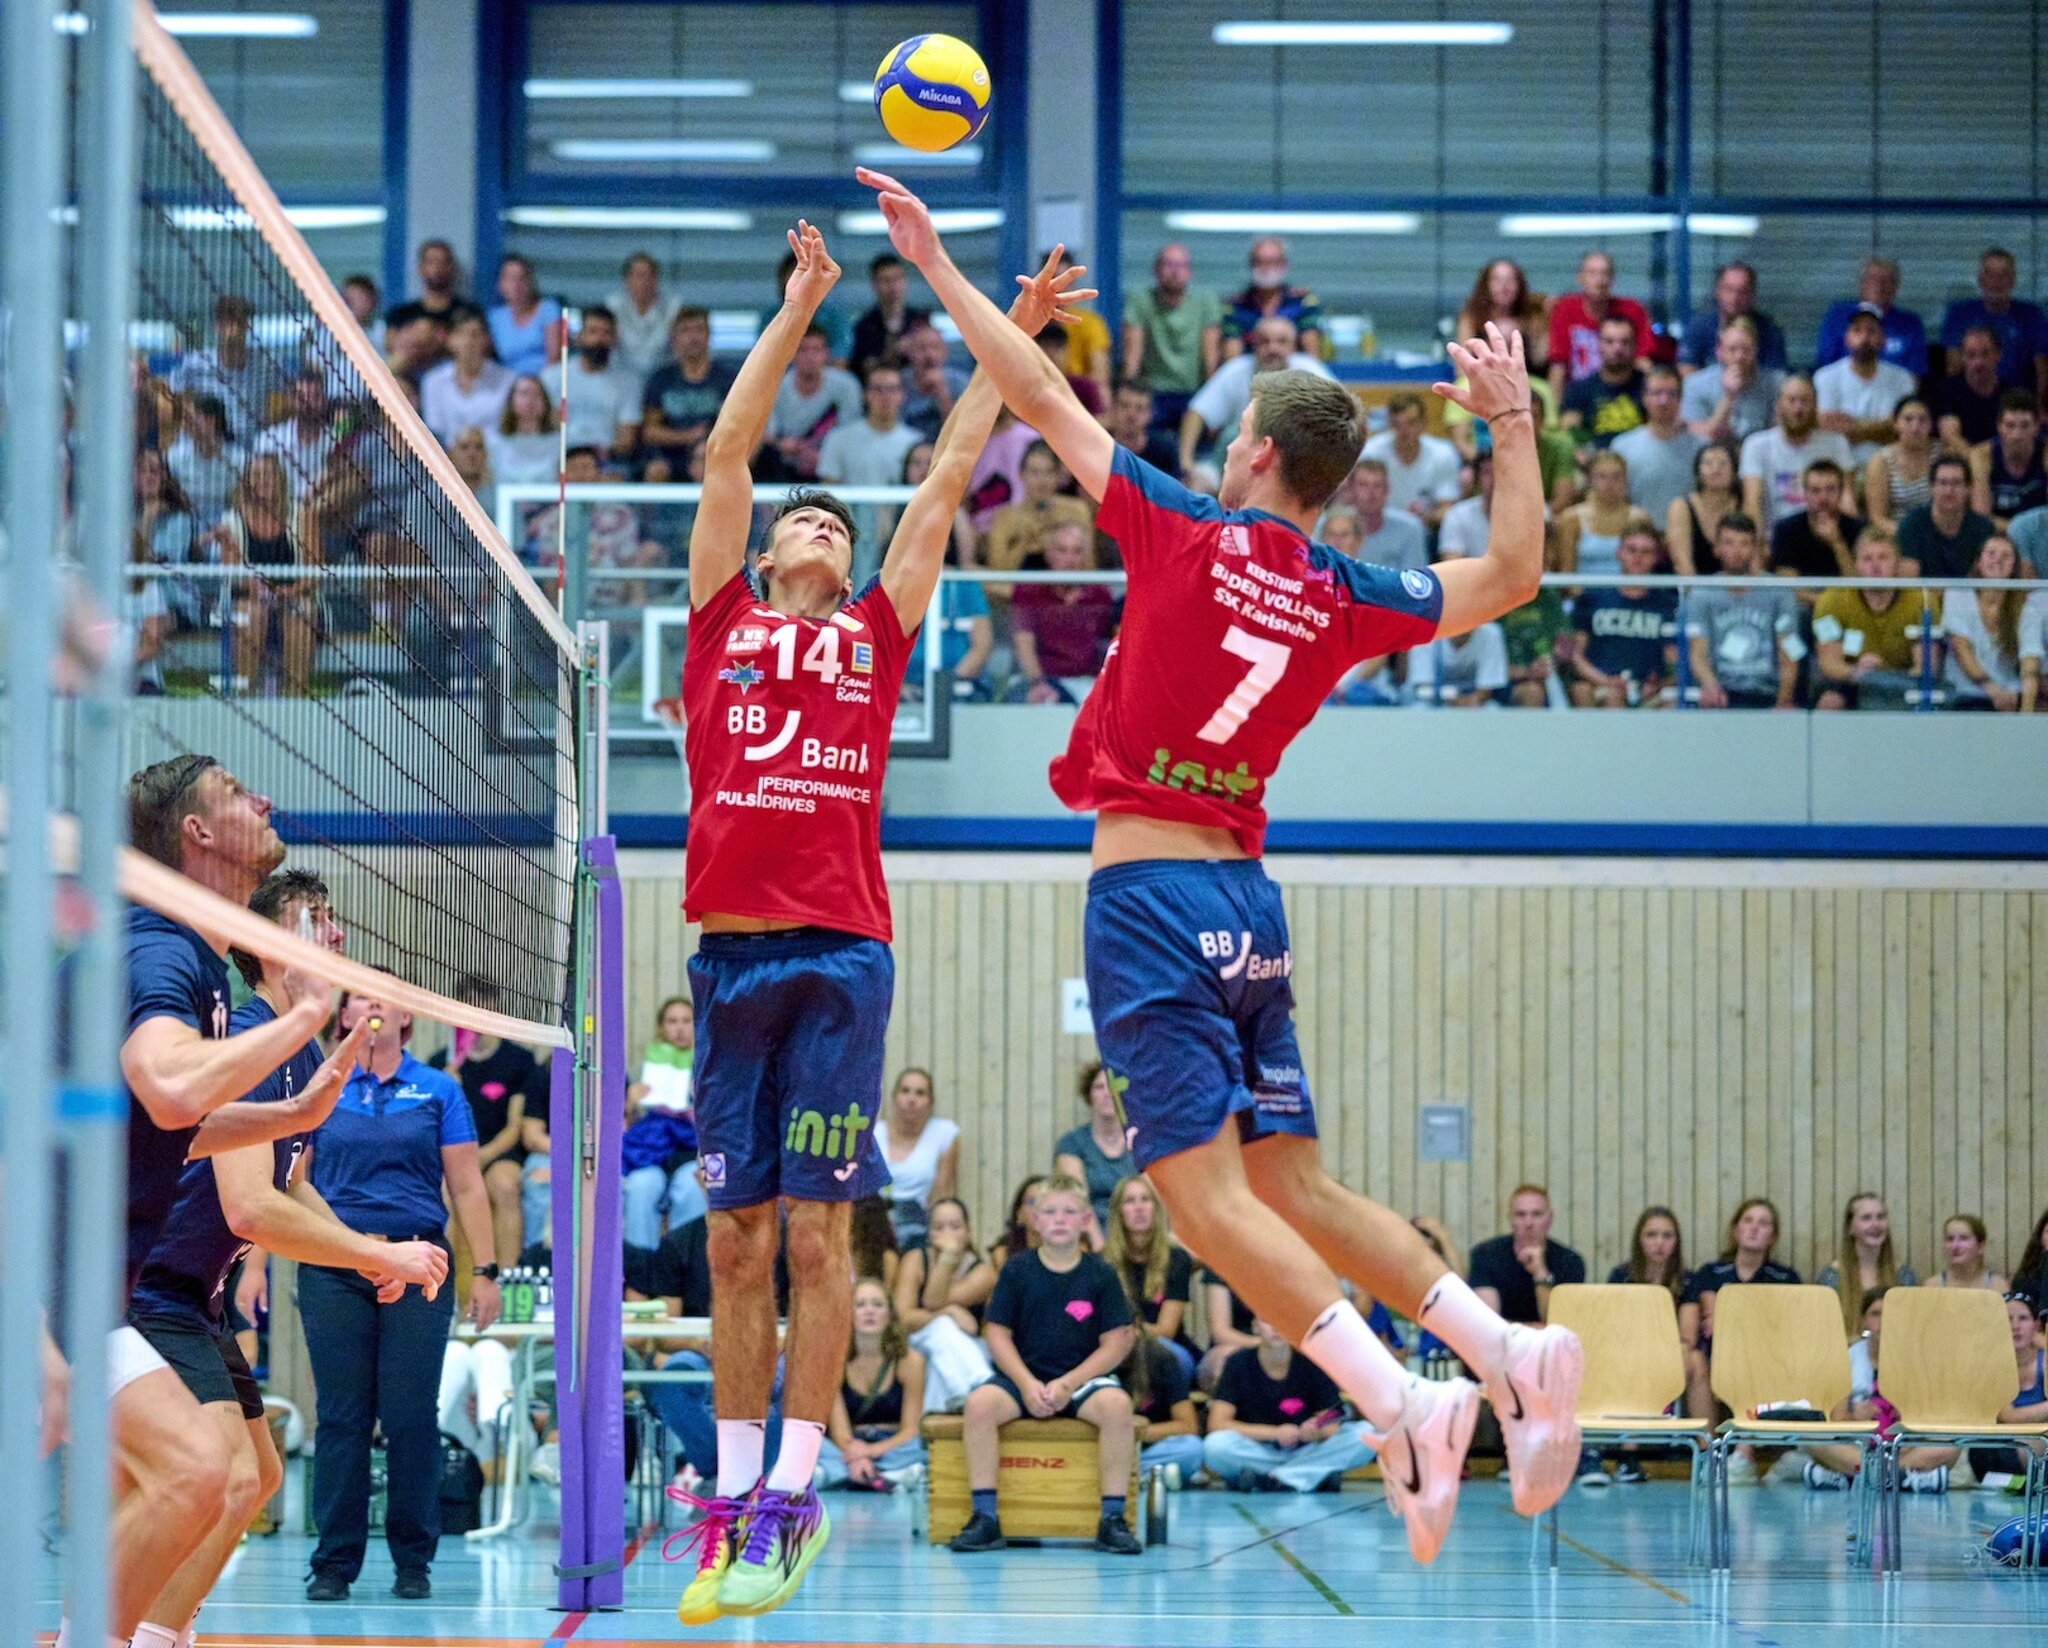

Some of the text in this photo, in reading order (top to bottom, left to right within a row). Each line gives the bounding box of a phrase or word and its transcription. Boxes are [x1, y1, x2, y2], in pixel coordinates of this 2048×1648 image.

[1245, 561, 1304, 595] KERSTING
[1240, 601, 1317, 643] Karlsruhe
[1263, 590, 1331, 628] VOLLEYS
[769, 624, 842, 684] 14
[1196, 624, 1292, 745] 7
[727, 704, 767, 735] BB
[716, 790, 816, 814] PULS DRIVES
[763, 776, 871, 804] PERFORMANCE
[1198, 930, 1234, 958] BB
[785, 1102, 870, 1160] init
[501, 1284, 534, 1318] 19
[999, 1456, 1065, 1469] BENZ
